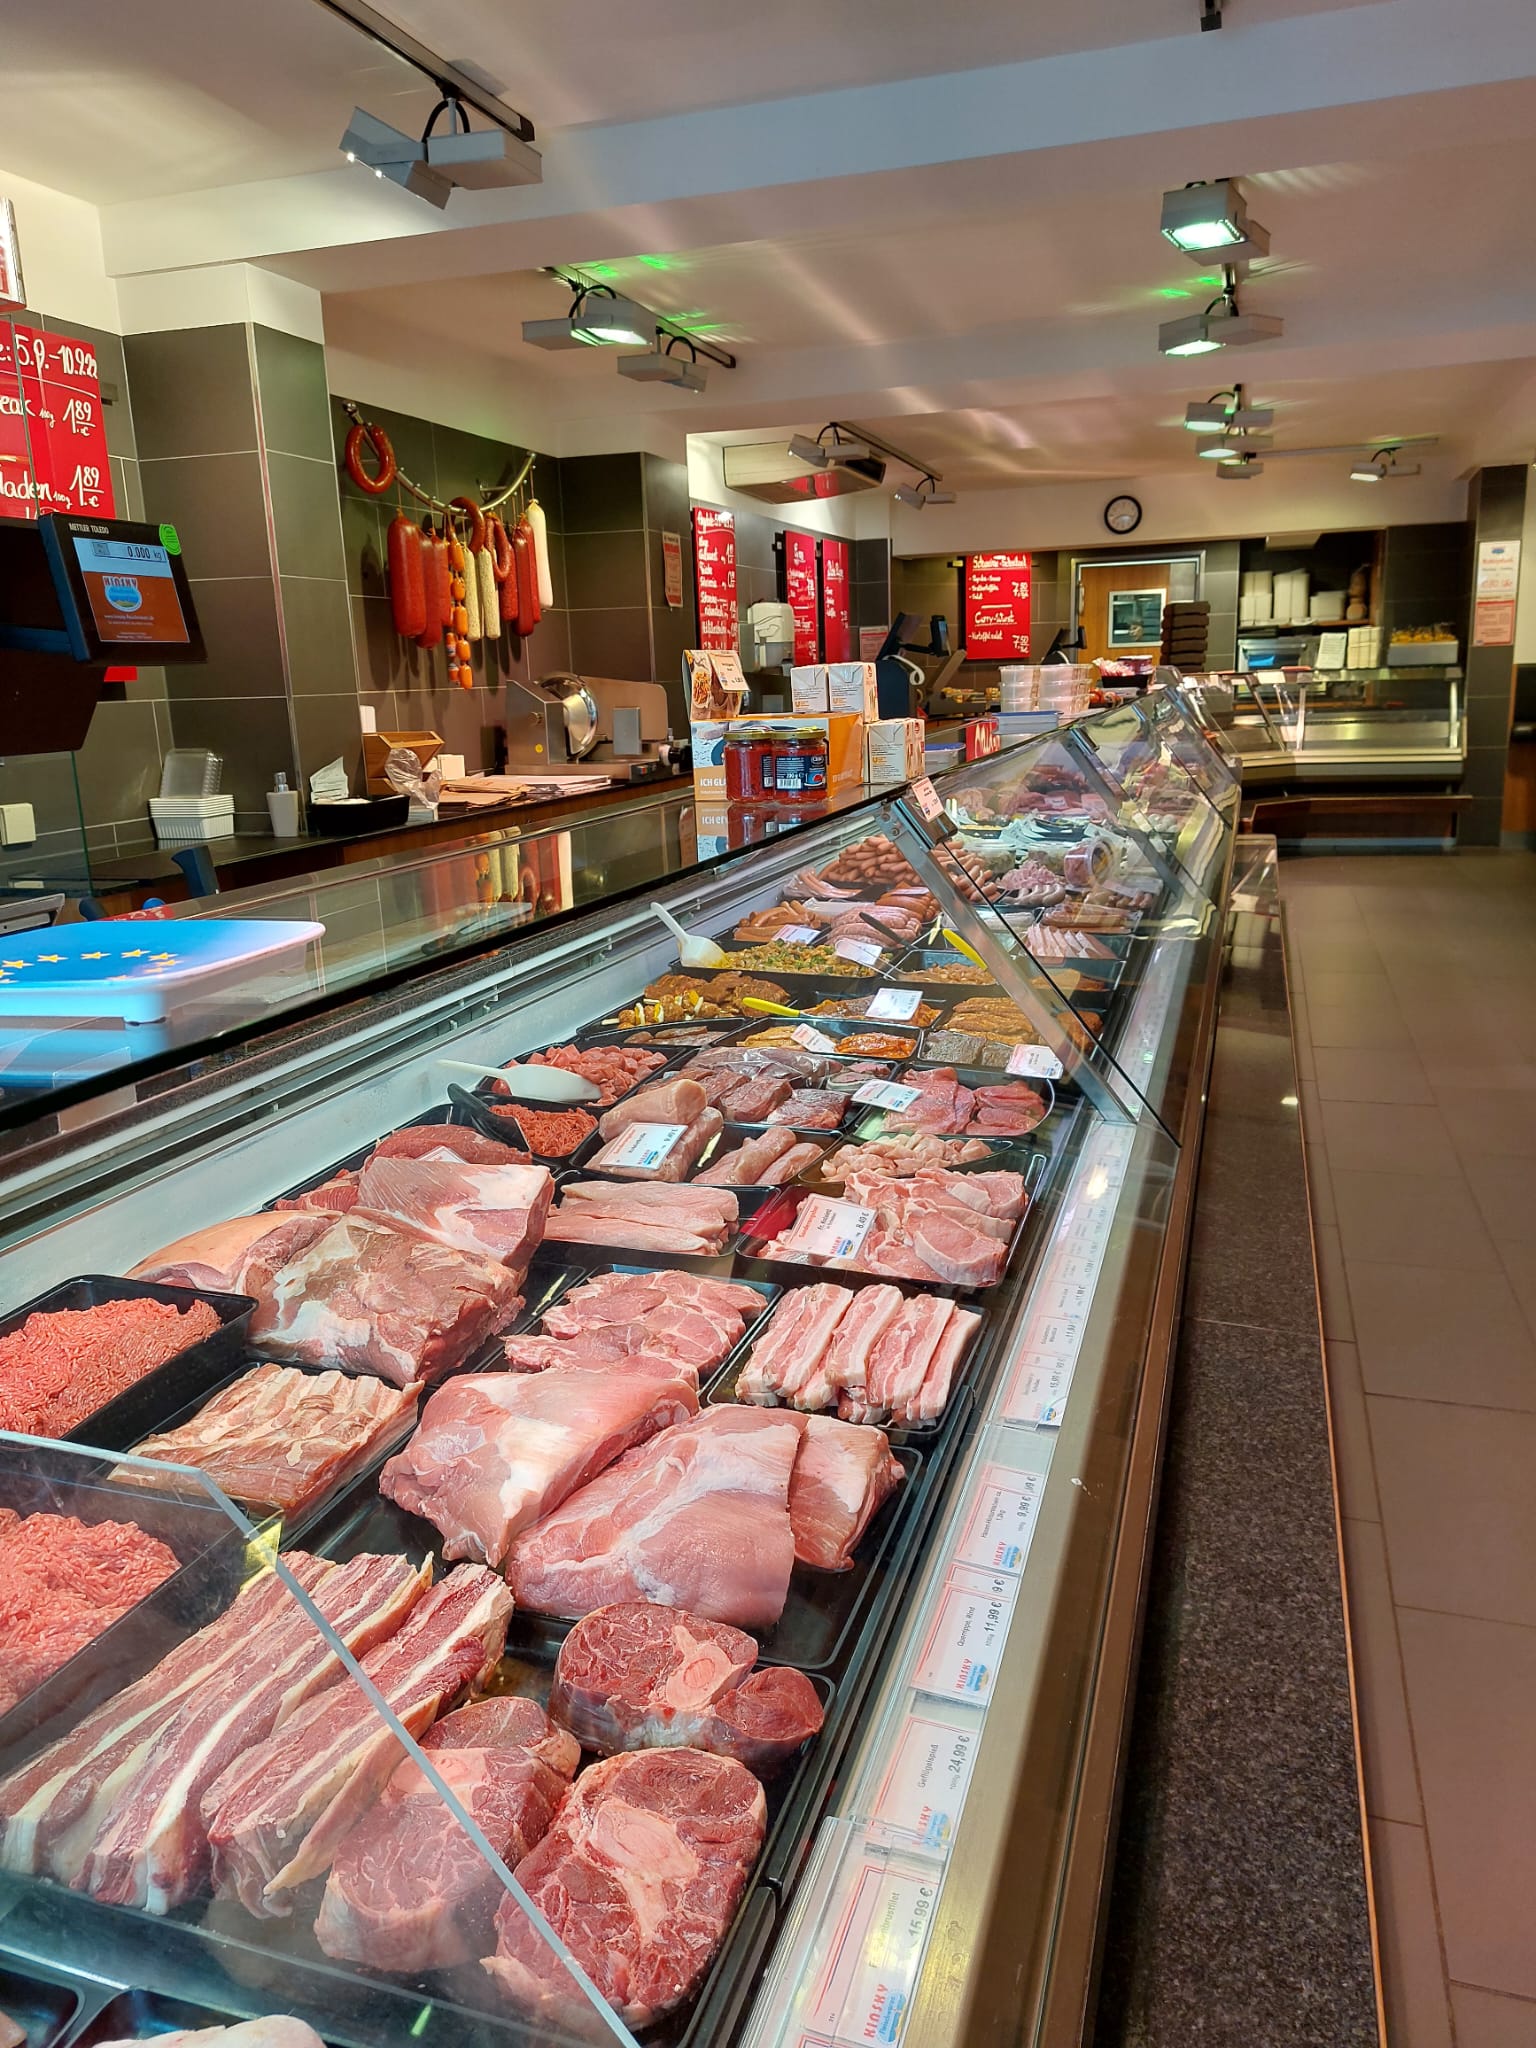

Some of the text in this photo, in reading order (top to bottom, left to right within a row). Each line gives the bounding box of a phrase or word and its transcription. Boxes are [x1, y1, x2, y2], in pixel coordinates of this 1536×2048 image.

[91, 524, 109, 534] TOLEDO
[127, 546, 151, 559] 0.000
[1017, 1502, 1030, 1517] 9,99
[966, 1606, 975, 1619] Rind
[983, 1608, 1000, 1632] 11,99
[955, 1658, 973, 1690] KINSKY
[948, 1744, 968, 1774] 24,99
[958, 1735, 970, 1743] €
[918, 1744, 939, 1788] Geflügelspieß
[920, 1887, 933, 1898] €
[864, 1984, 888, 2039] KINSKY
